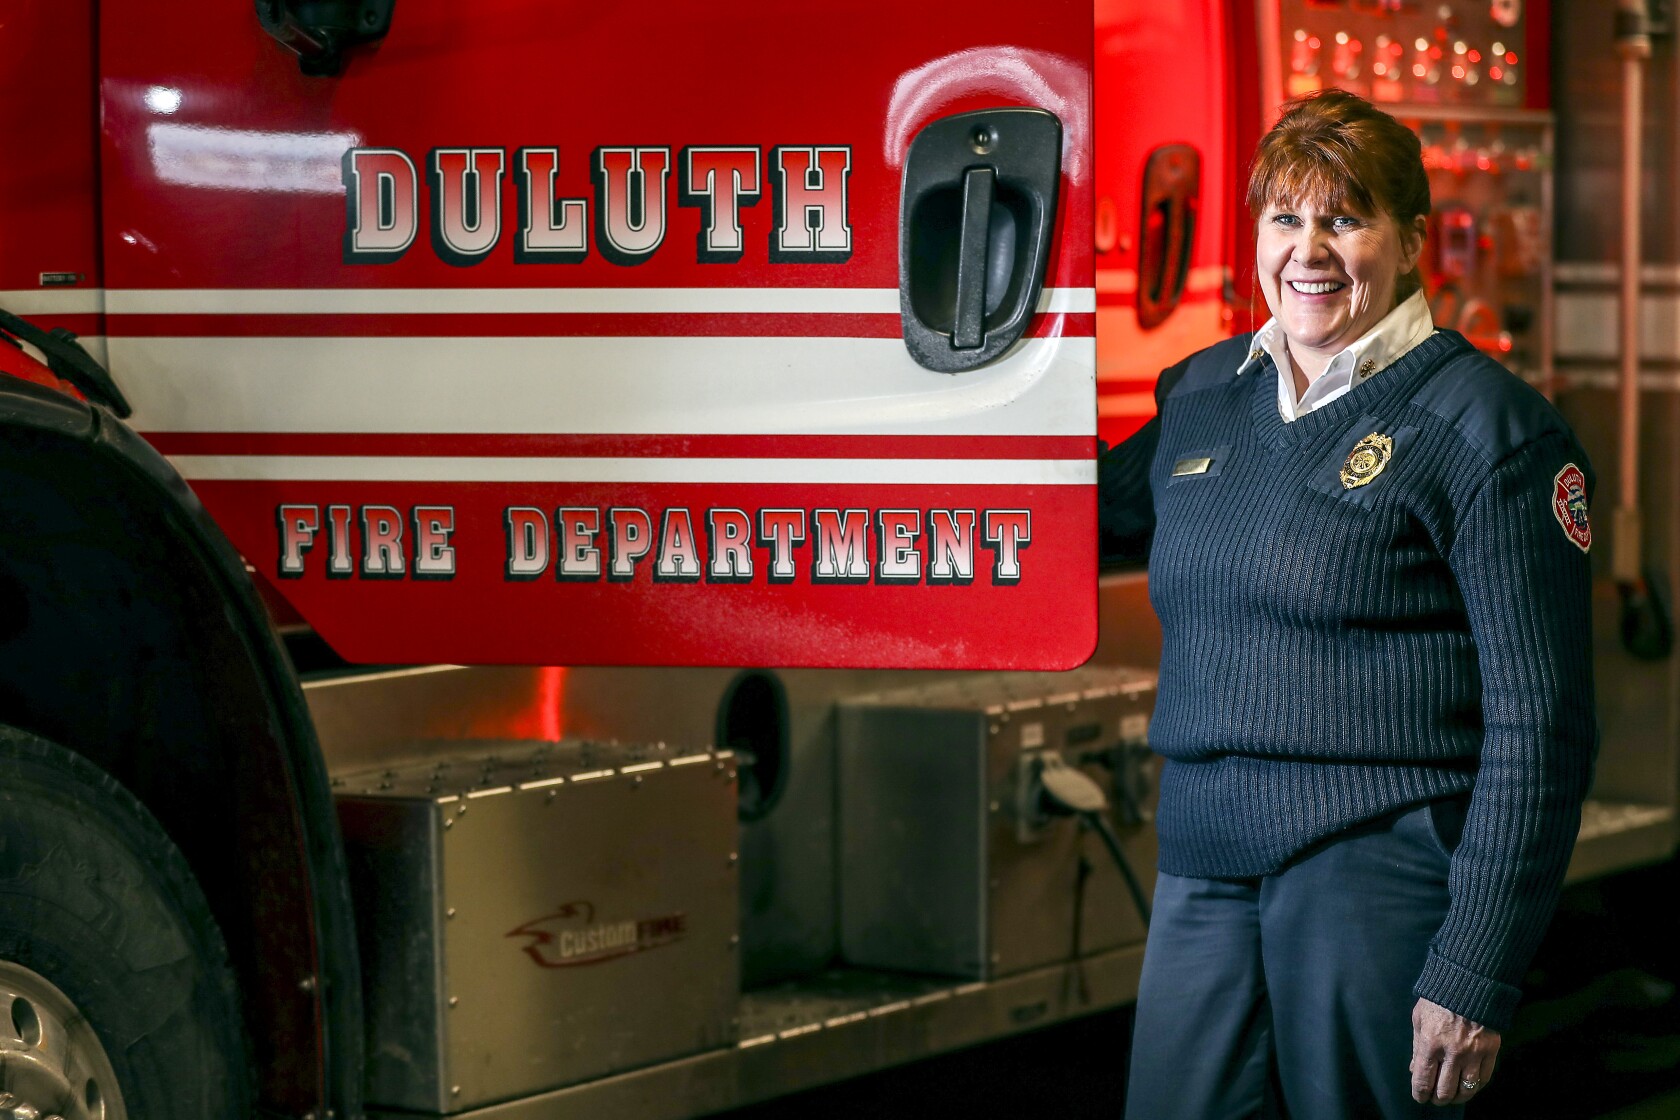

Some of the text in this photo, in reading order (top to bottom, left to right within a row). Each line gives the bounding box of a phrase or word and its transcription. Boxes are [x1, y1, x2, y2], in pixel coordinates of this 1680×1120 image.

[341, 144, 853, 266] DULUTH
[1563, 473, 1582, 487] DULUTH
[277, 504, 1031, 586] FIRE DEPARTMENT
[560, 920, 637, 958] Custom
